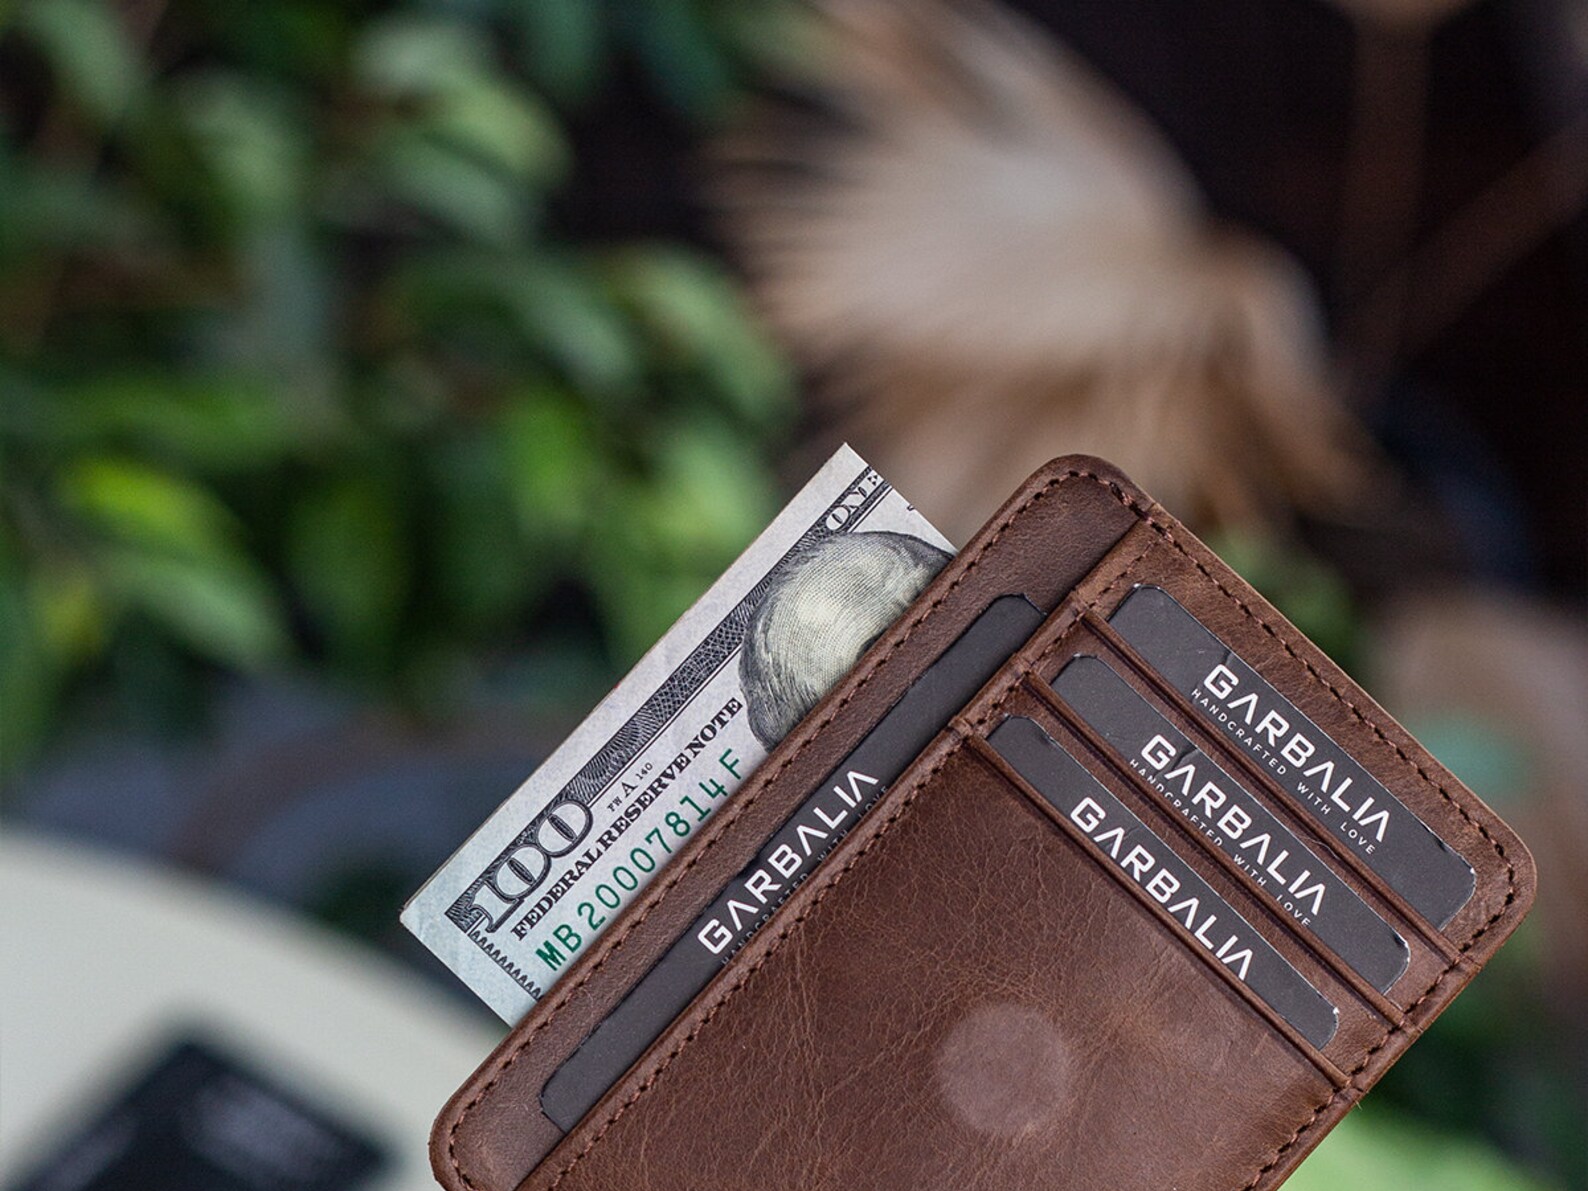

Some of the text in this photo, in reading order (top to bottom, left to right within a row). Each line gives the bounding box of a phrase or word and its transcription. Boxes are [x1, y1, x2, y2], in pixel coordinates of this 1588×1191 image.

[510, 697, 743, 941] FEDERAL RESERVE NOTE
[620, 782, 638, 798] A
[636, 763, 653, 781] 140
[1141, 734, 1326, 915] GARBALIA
[1191, 688, 1375, 855] HANDCRAFTED WITH LOVE
[1203, 663, 1391, 840] GARBALIA
[471, 798, 593, 934] 100
[535, 748, 742, 971] MB 20007814 F
[698, 769, 879, 955] GARBALIA
[1070, 797, 1253, 980] GARBALIA
[1233, 855, 1267, 887] WITH
